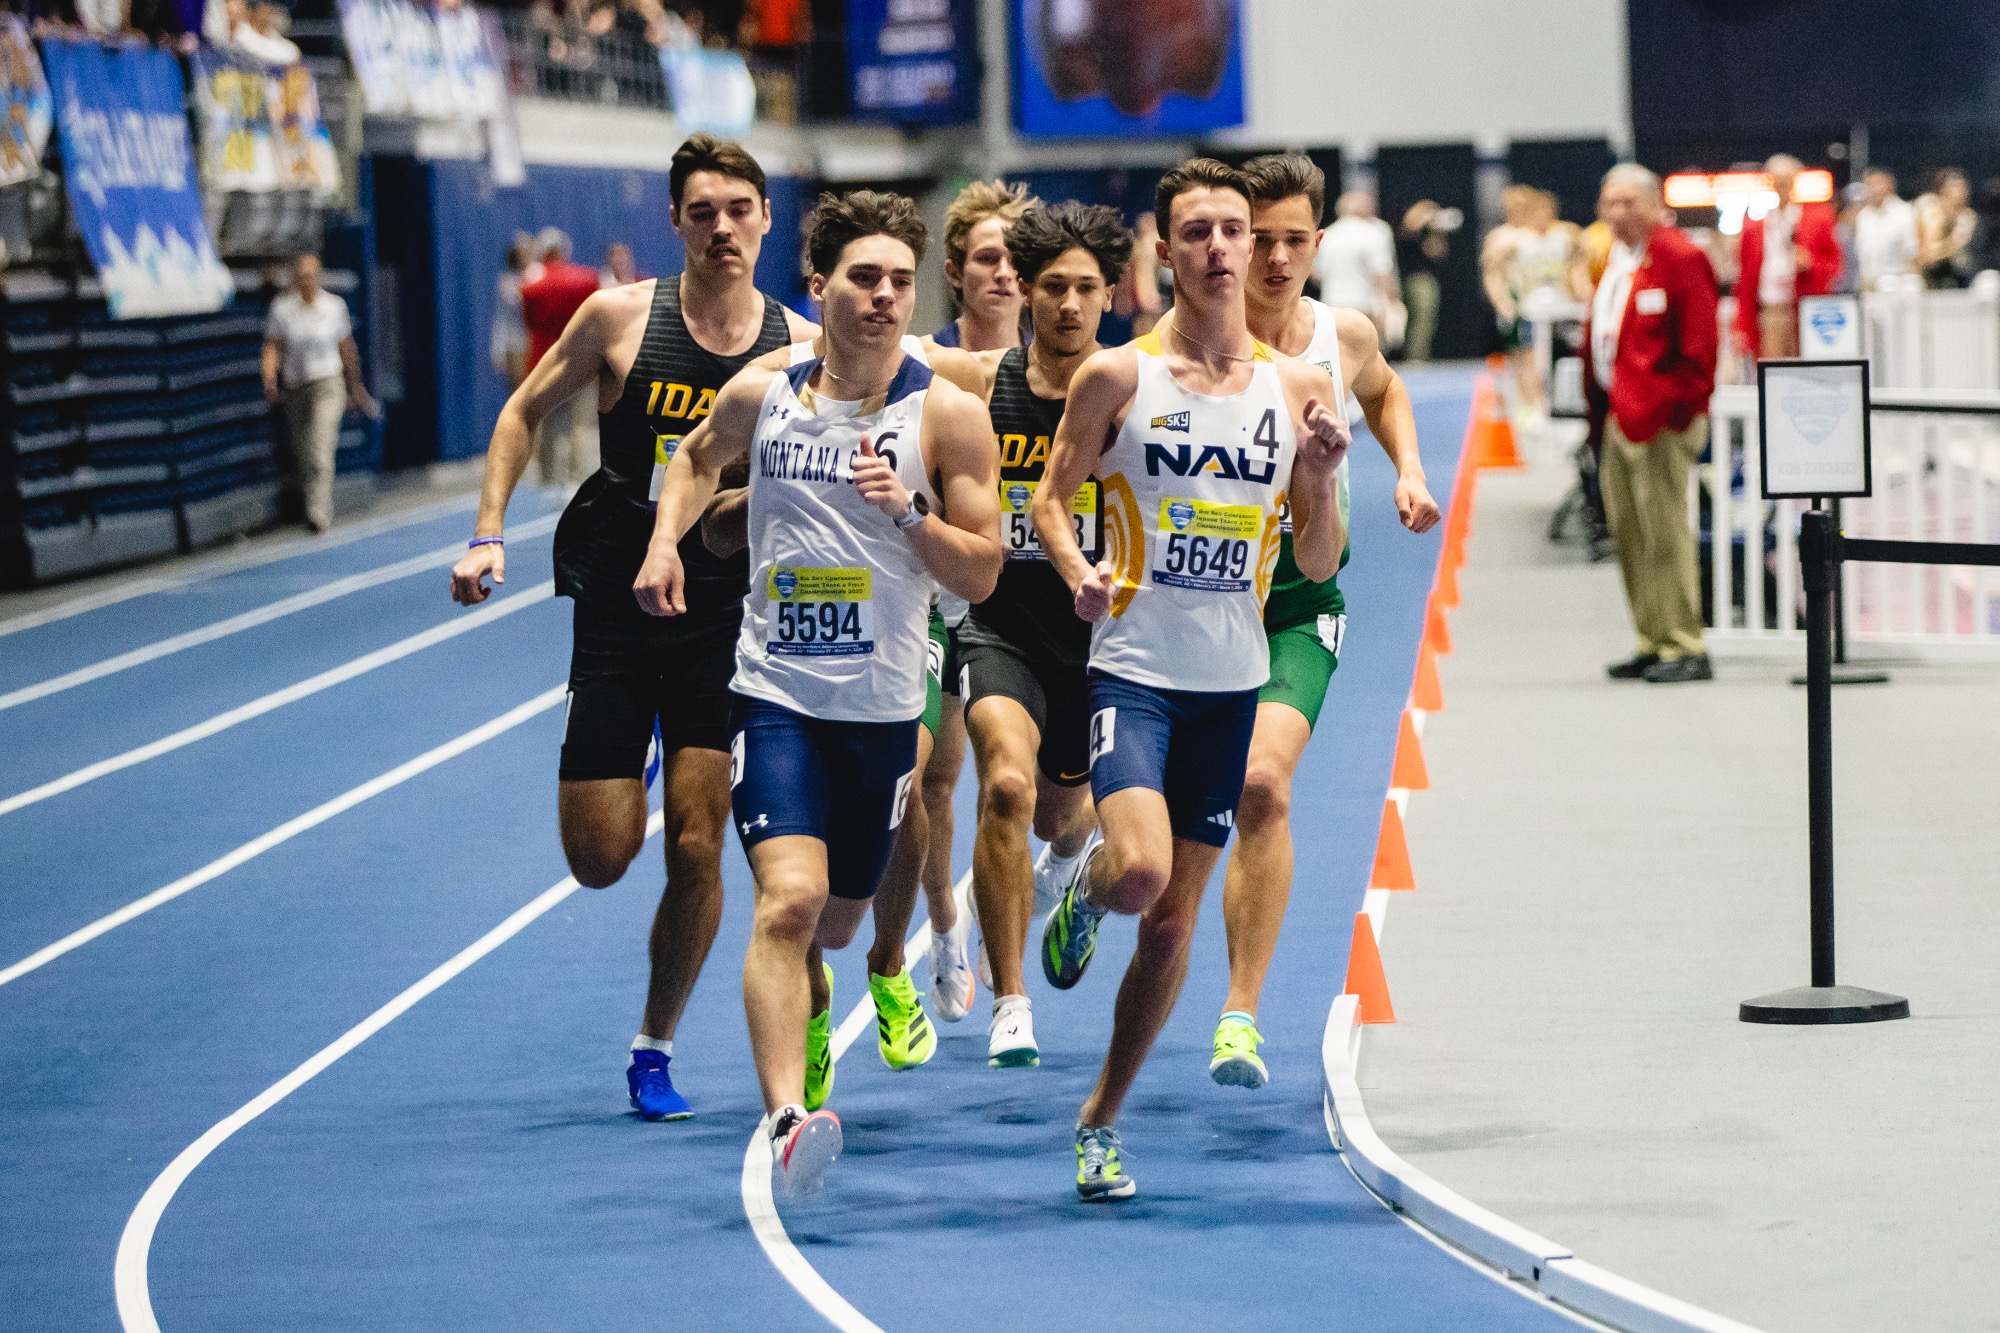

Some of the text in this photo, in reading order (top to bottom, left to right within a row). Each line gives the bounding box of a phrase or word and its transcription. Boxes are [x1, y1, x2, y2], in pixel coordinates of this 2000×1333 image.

[646, 381, 717, 420] IDA
[874, 431, 899, 472] 6
[1253, 408, 1280, 459] 4
[760, 439, 840, 484] MONTANA
[1143, 443, 1277, 485] NAU
[1010, 513, 1085, 549] 543
[1166, 533, 1249, 579] 5649
[778, 602, 862, 642] 5594
[1091, 712, 1107, 755] 4
